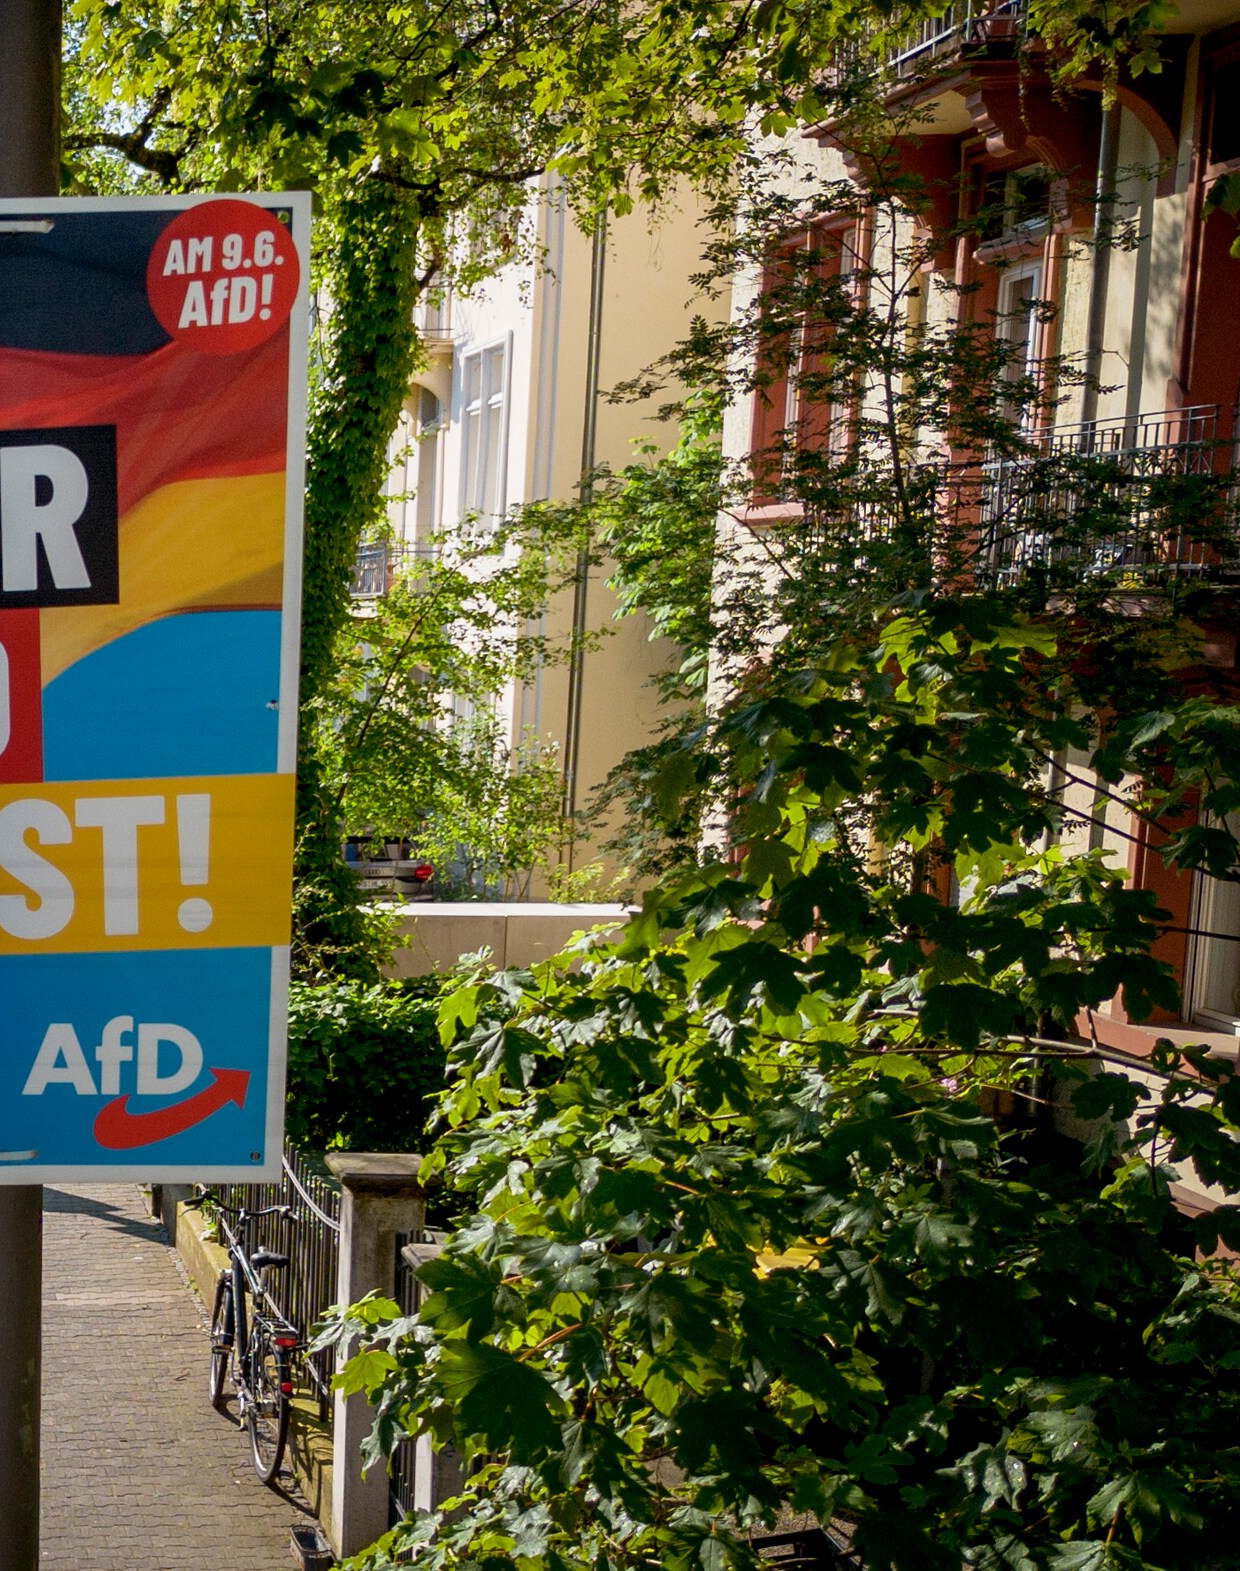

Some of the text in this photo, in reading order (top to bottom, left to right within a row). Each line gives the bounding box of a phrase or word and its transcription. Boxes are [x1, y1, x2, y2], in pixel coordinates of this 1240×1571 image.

[162, 230, 285, 276] AM 9.6.
[177, 274, 274, 329] AfD!
[22, 1015, 203, 1096] AfD
